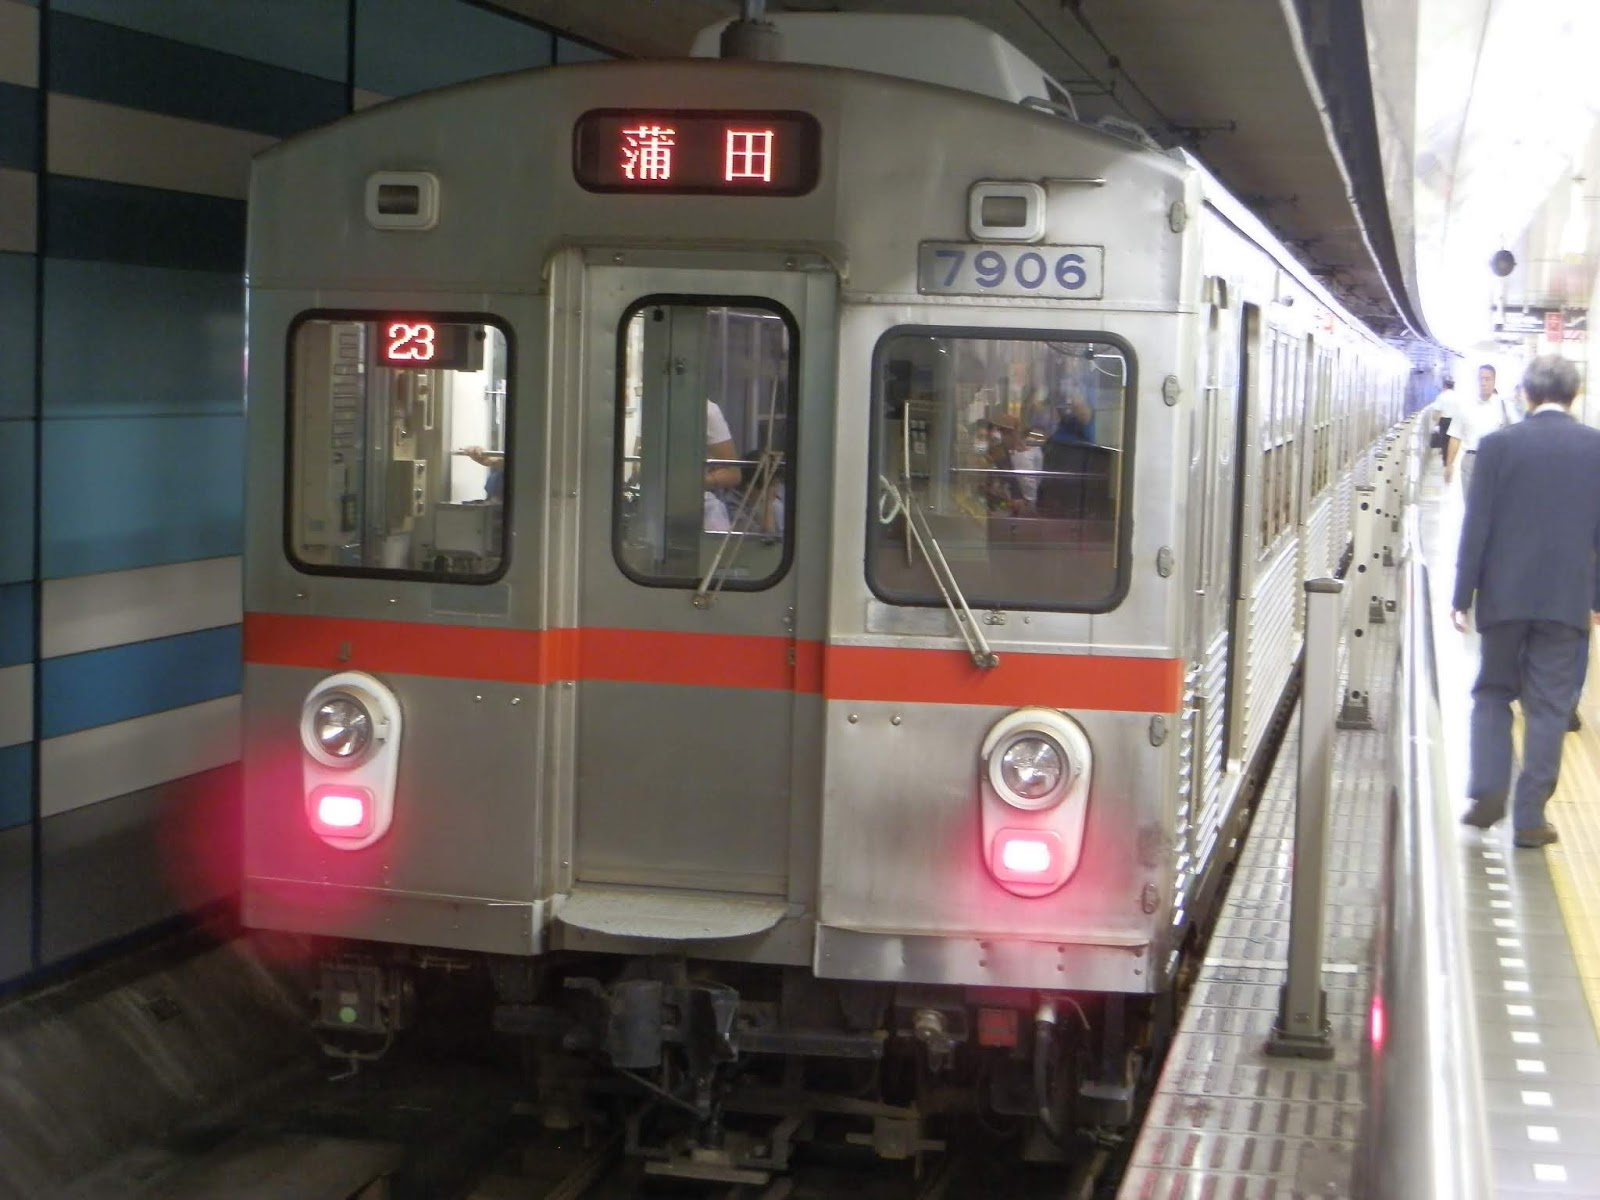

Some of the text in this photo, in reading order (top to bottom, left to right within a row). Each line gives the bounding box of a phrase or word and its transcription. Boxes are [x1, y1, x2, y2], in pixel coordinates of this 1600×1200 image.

[621, 126, 774, 182] 蒲田
[935, 250, 1087, 290] 7906
[388, 323, 435, 361] 23
